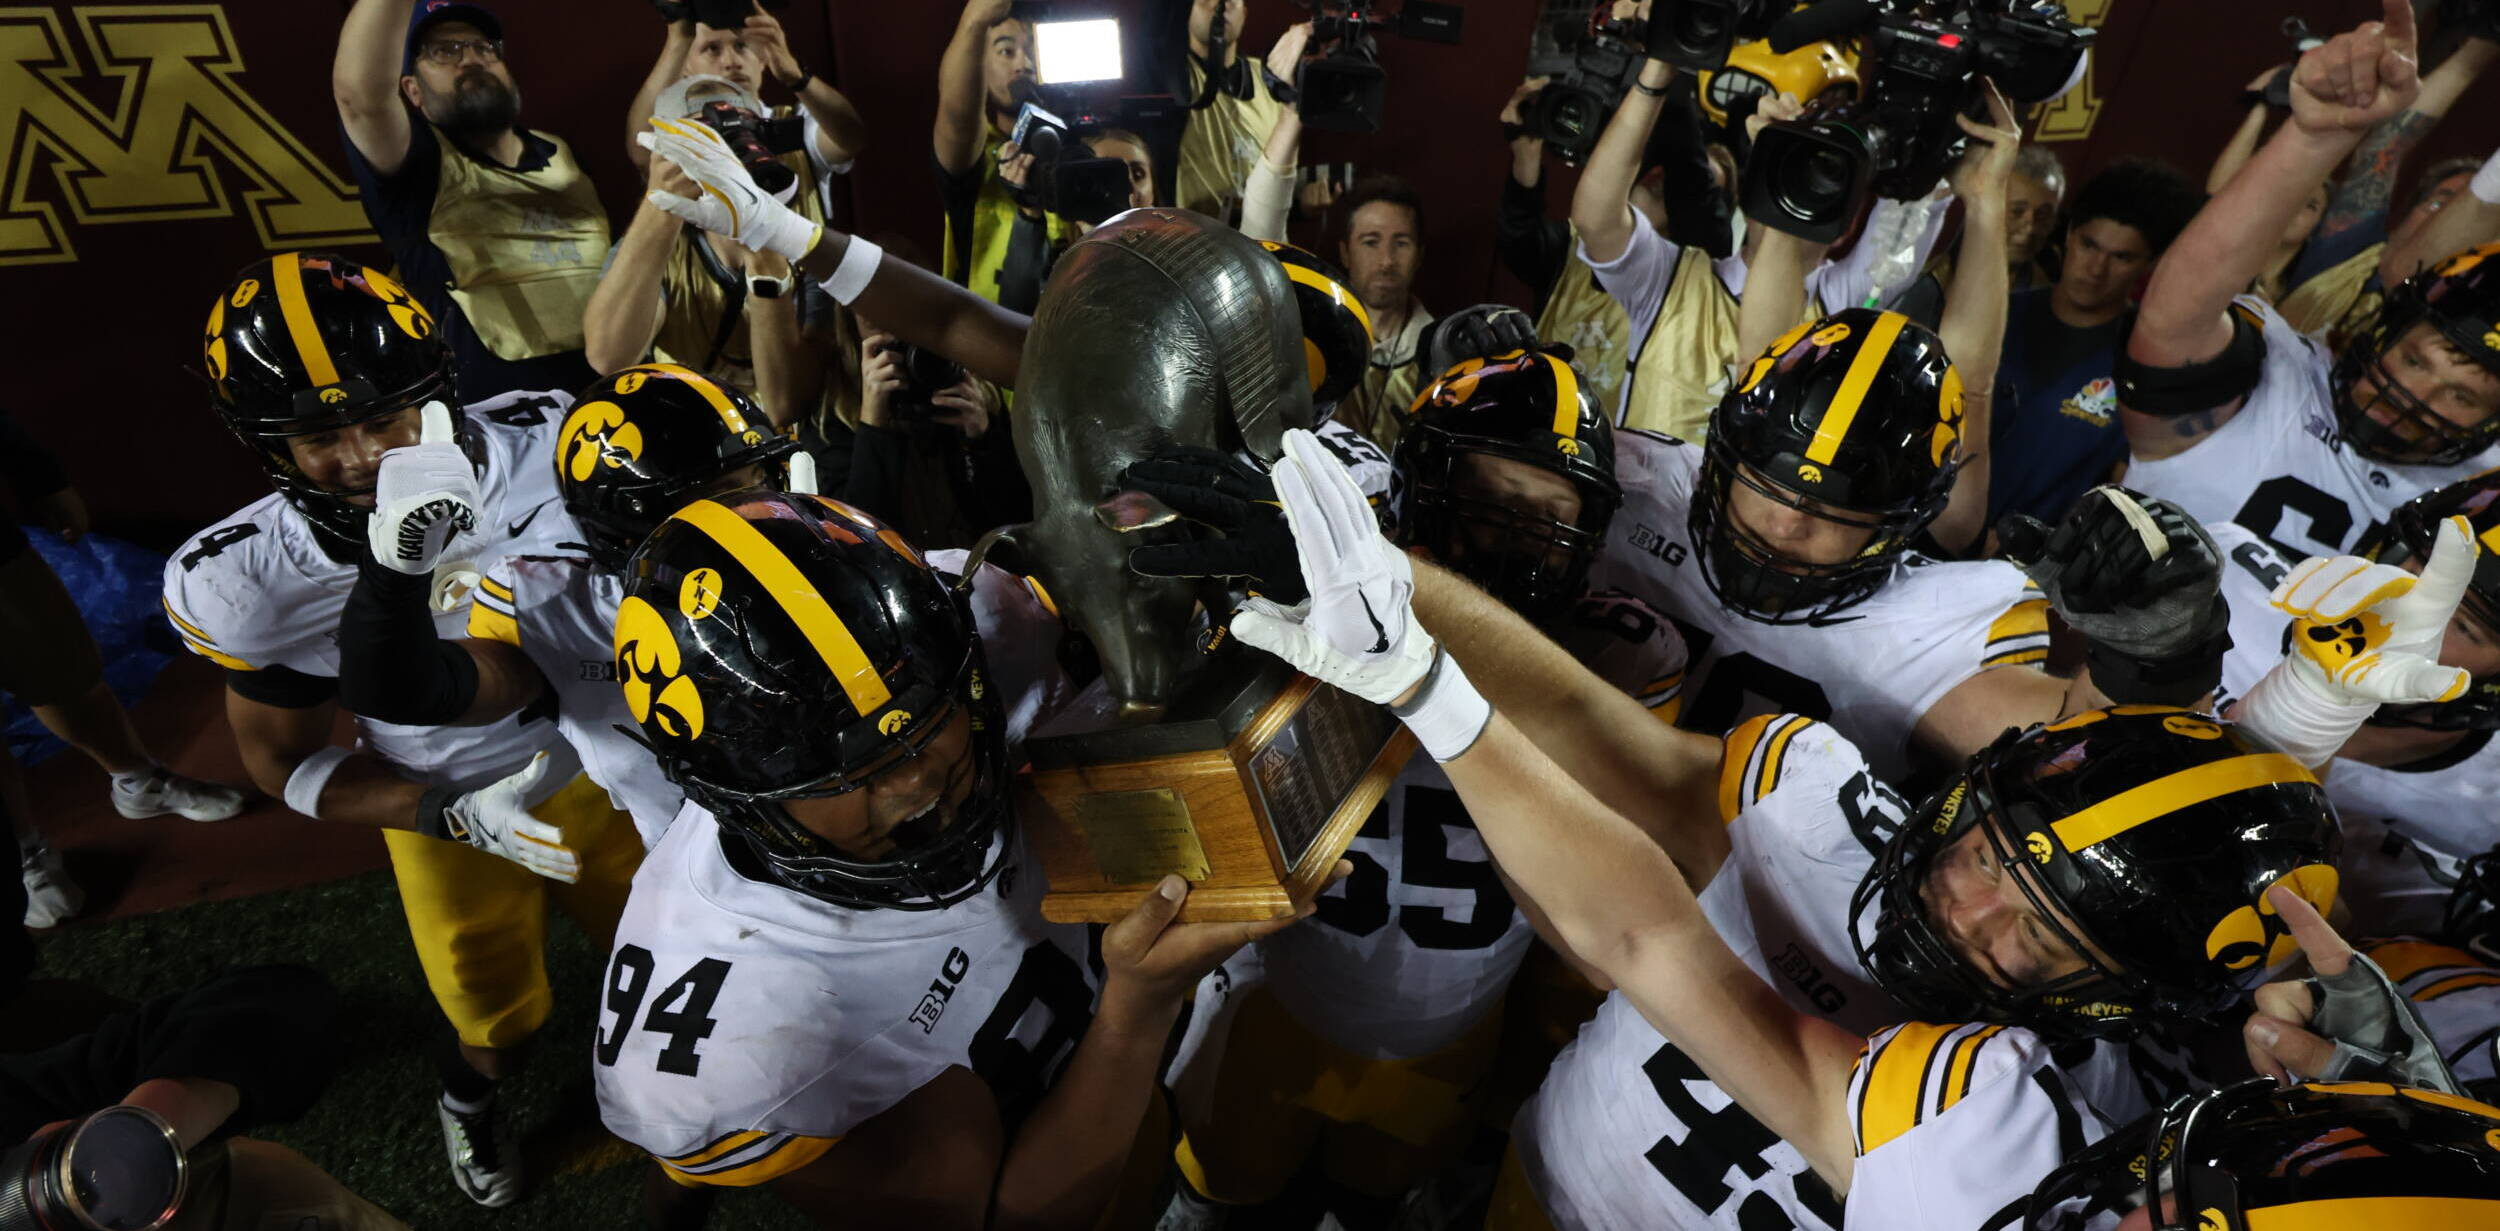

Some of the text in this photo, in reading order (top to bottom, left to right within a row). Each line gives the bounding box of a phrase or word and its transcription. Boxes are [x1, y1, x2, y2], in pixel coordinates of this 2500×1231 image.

[0, 2, 383, 267] M
[486, 396, 561, 427] 4
[180, 522, 262, 573] 4
[397, 498, 475, 560] HAWKEYES
[597, 943, 734, 1078] 94
